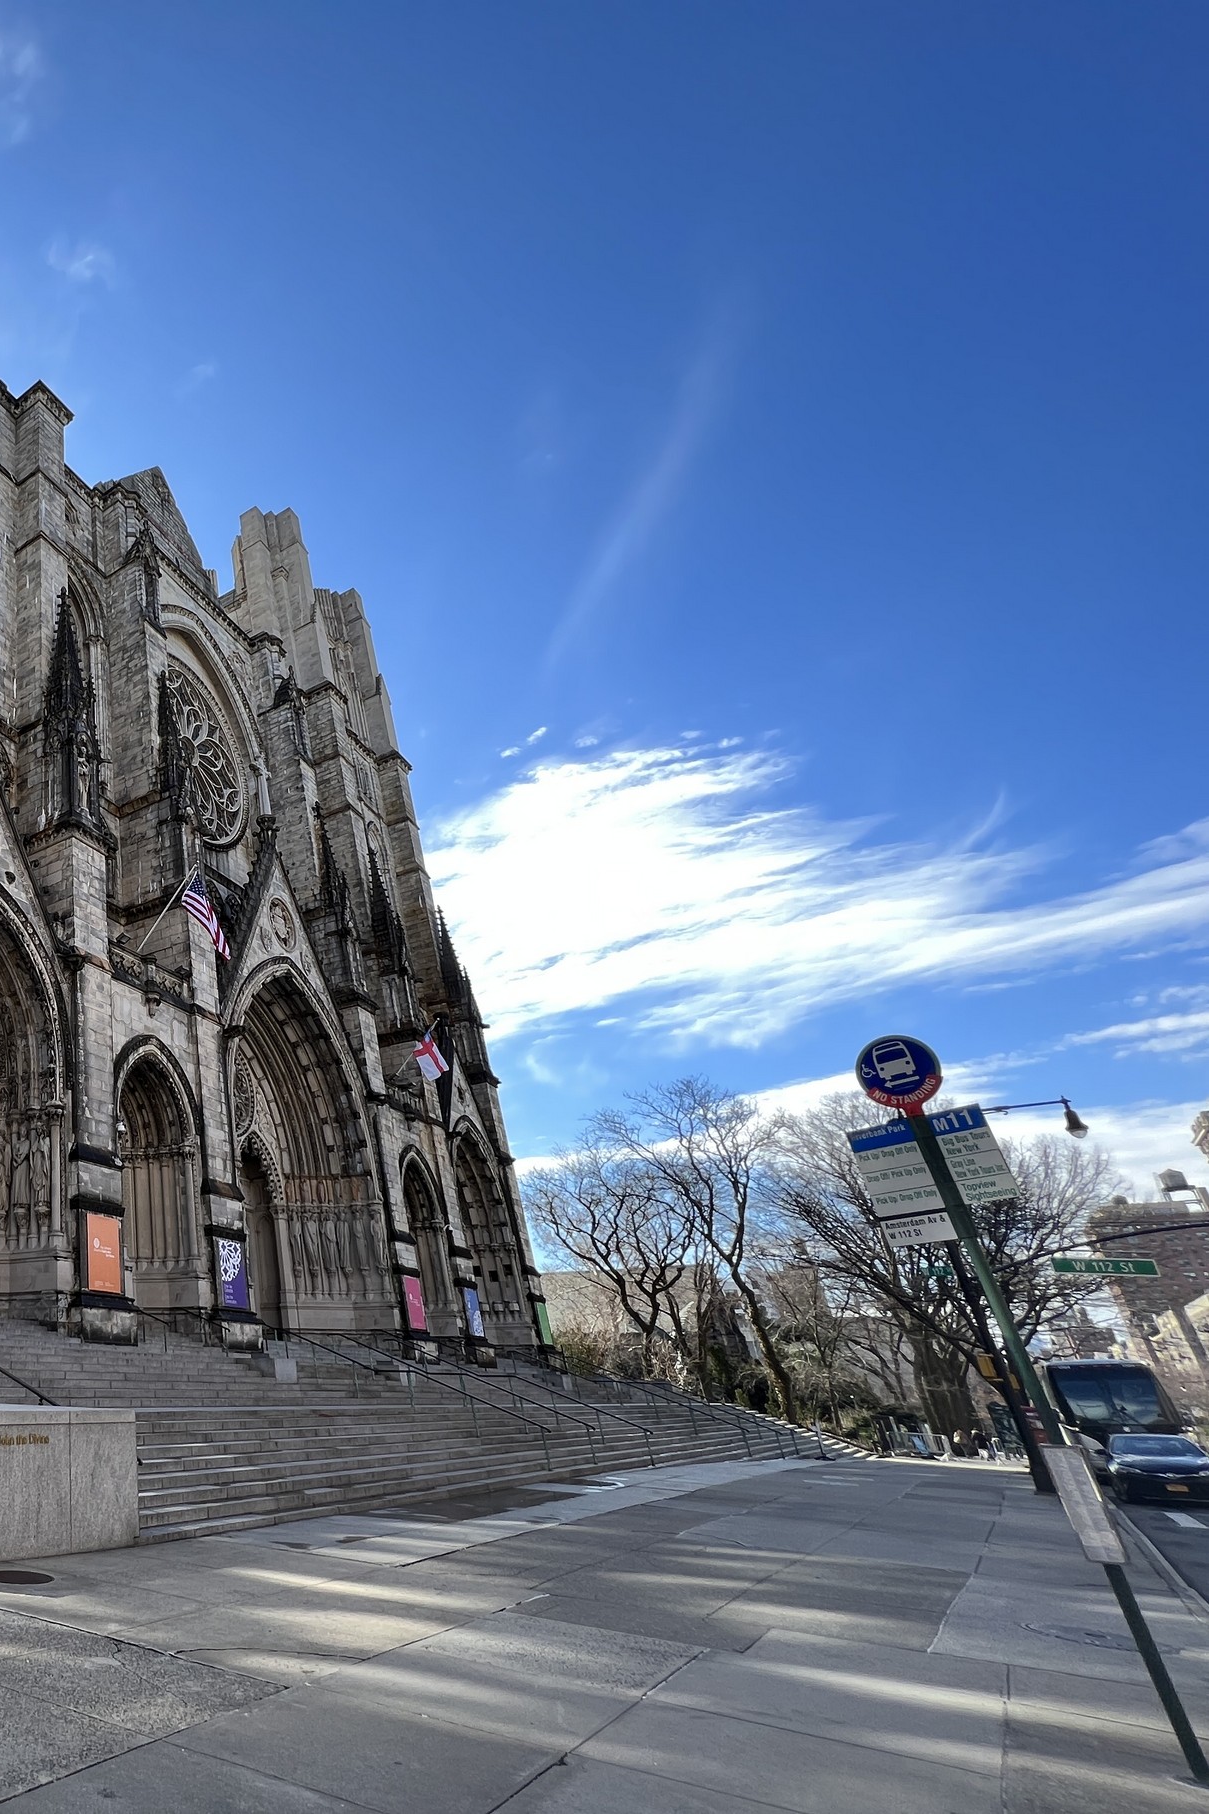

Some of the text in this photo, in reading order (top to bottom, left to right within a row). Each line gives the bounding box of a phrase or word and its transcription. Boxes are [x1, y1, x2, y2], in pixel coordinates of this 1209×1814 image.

[873, 1078, 935, 1104] NO STANDING
[932, 1109, 973, 1132] M11
[887, 1123, 906, 1134] Park
[955, 1135, 969, 1143] Bus
[969, 1131, 990, 1140] Tours
[945, 1143, 980, 1156] New York
[950, 1160, 964, 1169] Gray
[960, 1180, 996, 1192] Topview
[875, 1197, 889, 1205] Pick
[966, 1188, 1017, 1202] Sightseeing
[885, 1218, 926, 1230] Amsterdam
[939, 1214, 946, 1222] &
[888, 1232, 896, 1240] W
[898, 1230, 912, 1238] 112
[1072, 1260, 1136, 1273] W 112 St
[16, 1434, 28, 1445] the
[28, 1433, 50, 1445] Divine
